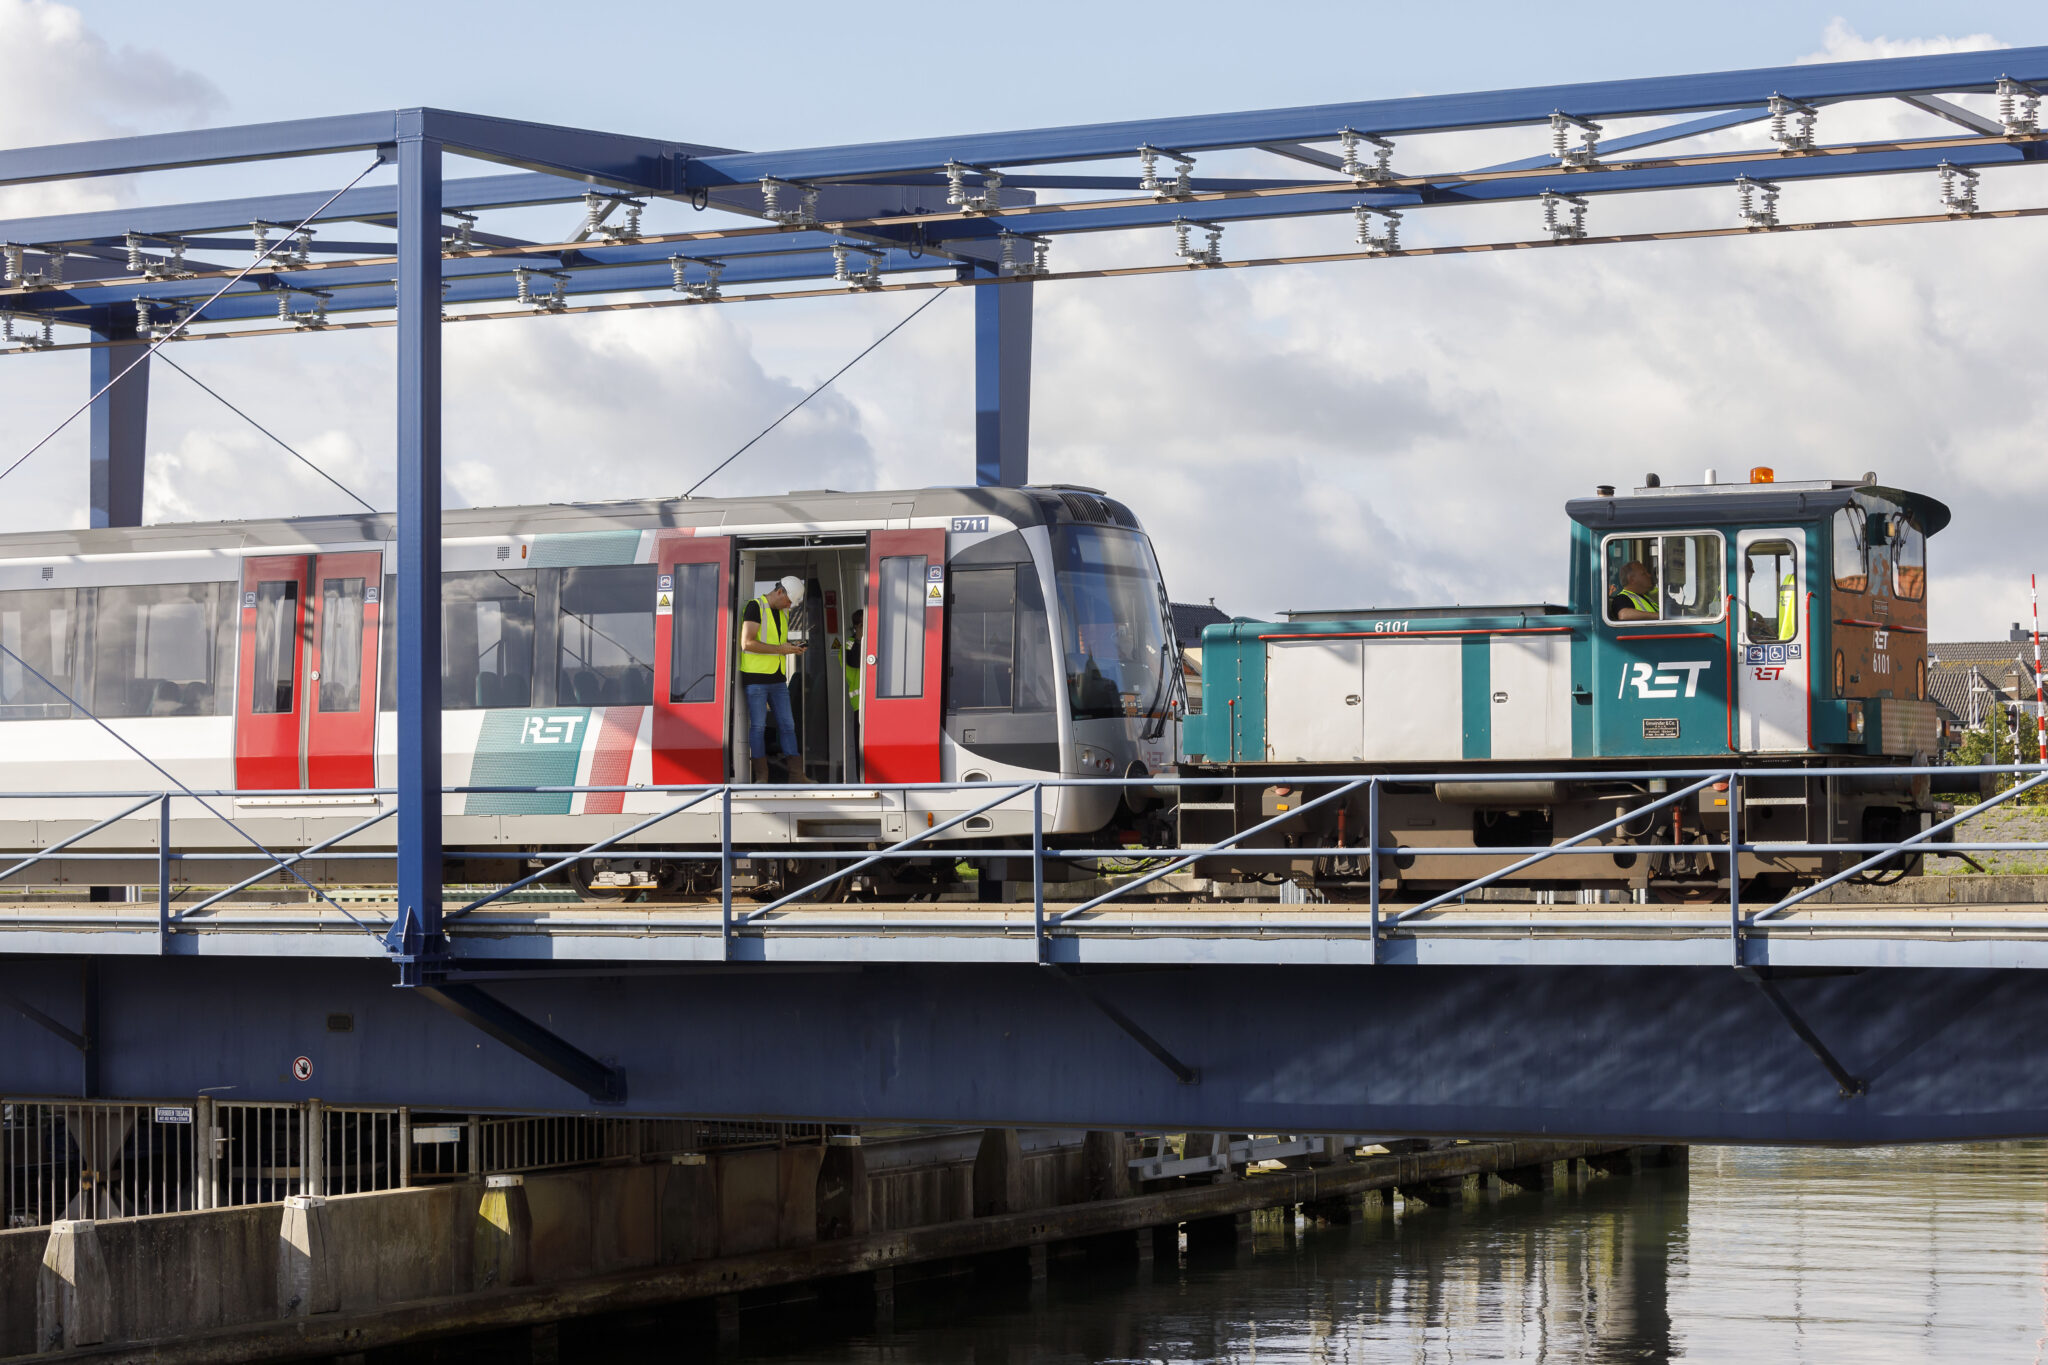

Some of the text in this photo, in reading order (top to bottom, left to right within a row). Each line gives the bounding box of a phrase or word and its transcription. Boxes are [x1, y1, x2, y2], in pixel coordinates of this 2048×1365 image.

[954, 519, 986, 531] 5711
[1374, 620, 1409, 633] 6101
[1872, 630, 1889, 650] RET
[1750, 667, 1784, 680] RET
[1873, 652, 1890, 675] 6101
[1618, 660, 1711, 700] RET
[520, 715, 584, 745] RET
